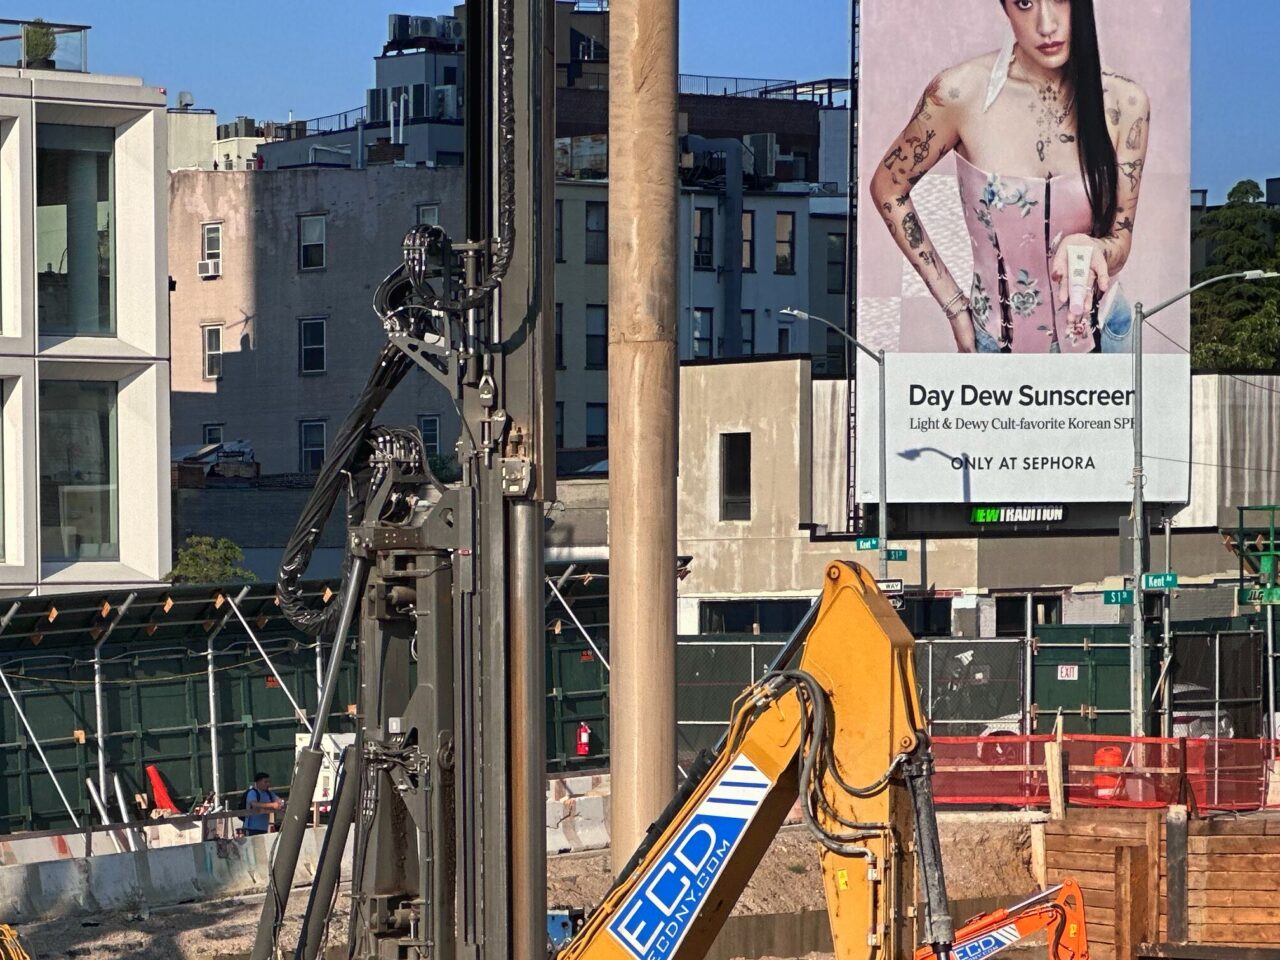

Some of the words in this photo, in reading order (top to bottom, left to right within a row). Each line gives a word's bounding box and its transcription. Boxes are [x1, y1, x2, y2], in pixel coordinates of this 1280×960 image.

[909, 384, 954, 411] Day
[961, 384, 1013, 406] Dew
[1018, 384, 1135, 406] Sunscreen
[909, 417, 940, 433] Light
[942, 417, 953, 430] &
[955, 417, 989, 433] Dewy
[992, 417, 1065, 430] Cult-favorite
[1068, 417, 1111, 430] Korean
[951, 456, 993, 470] ONLY
[999, 457, 1018, 470] AT
[1022, 456, 1096, 470] SEPHORA
[860, 540, 871, 549] Kent
[1148, 576, 1164, 588] Kent
[1111, 592, 1116, 603] S
[1247, 589, 1264, 602] JLG
[1060, 666, 1075, 679] EXIT
[616, 823, 717, 956] ECD
